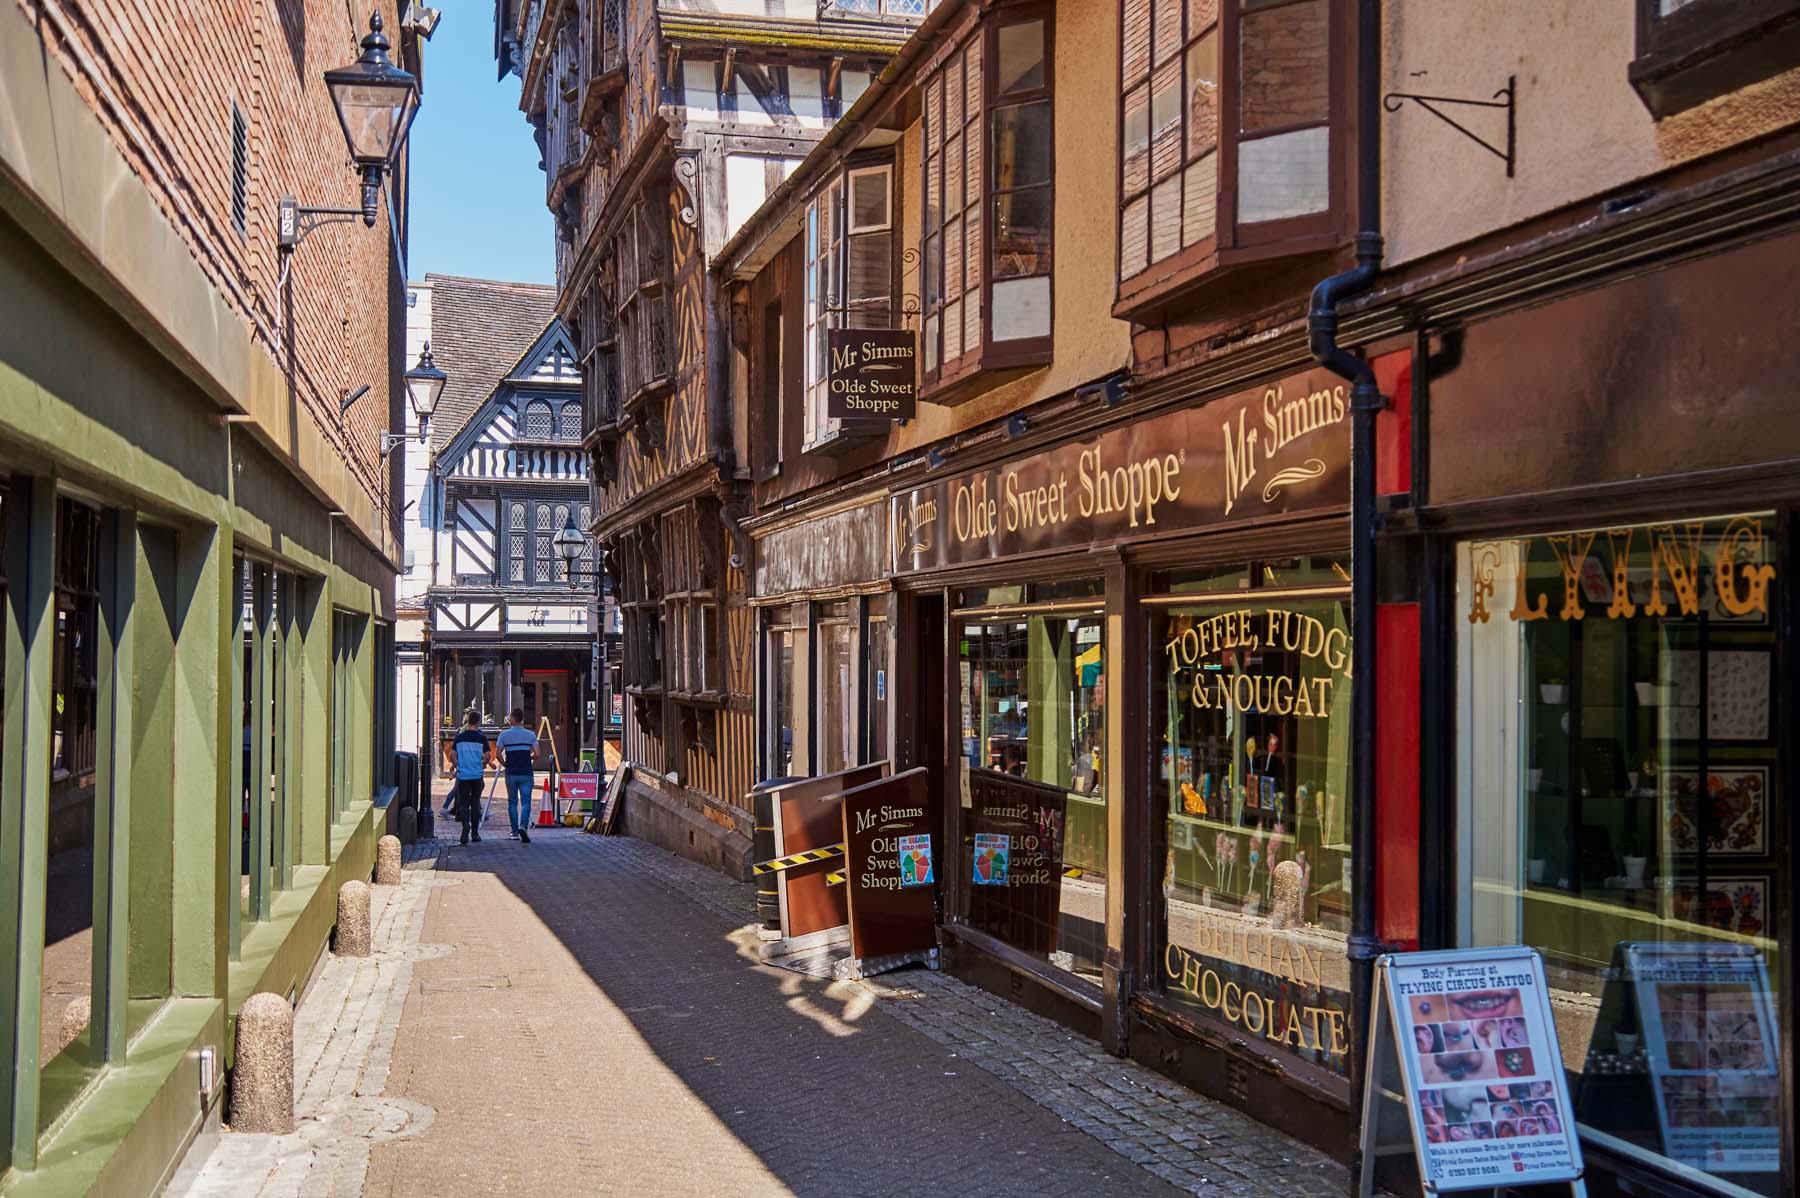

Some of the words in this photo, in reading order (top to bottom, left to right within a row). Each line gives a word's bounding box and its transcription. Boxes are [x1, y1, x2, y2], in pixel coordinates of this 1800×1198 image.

[831, 344, 858, 375] Mr
[862, 341, 914, 362] Simms
[831, 379, 867, 393] Olde
[870, 379, 913, 394] Sweet
[846, 395, 900, 413] Shoppe
[1222, 406, 1258, 517] Mr
[1263, 385, 1345, 459] Simms
[955, 477, 998, 542] Olde
[1005, 471, 1068, 532] Sweet
[1468, 515, 1776, 625] FLYING
[1165, 609, 1259, 674] TOFFEE,
[1192, 673, 1212, 709] &
[1216, 674, 1333, 718] NOUGAT
[855, 808, 877, 835] Mr
[880, 805, 923, 822] Simms
[871, 837, 898, 853] Old
[867, 855, 901, 870] Swe
[861, 872, 903, 891] Shop
[1199, 912, 1323, 994] BELGIAN
[1400, 980, 1443, 995] FLYING
[1446, 977, 1487, 992] CIRCUS
[1489, 973, 1533, 988] TATTOO
[1421, 968, 1445, 980] Body
[1447, 966, 1486, 978] Piercing
[1164, 943, 1351, 1056] CHOCOLATE
